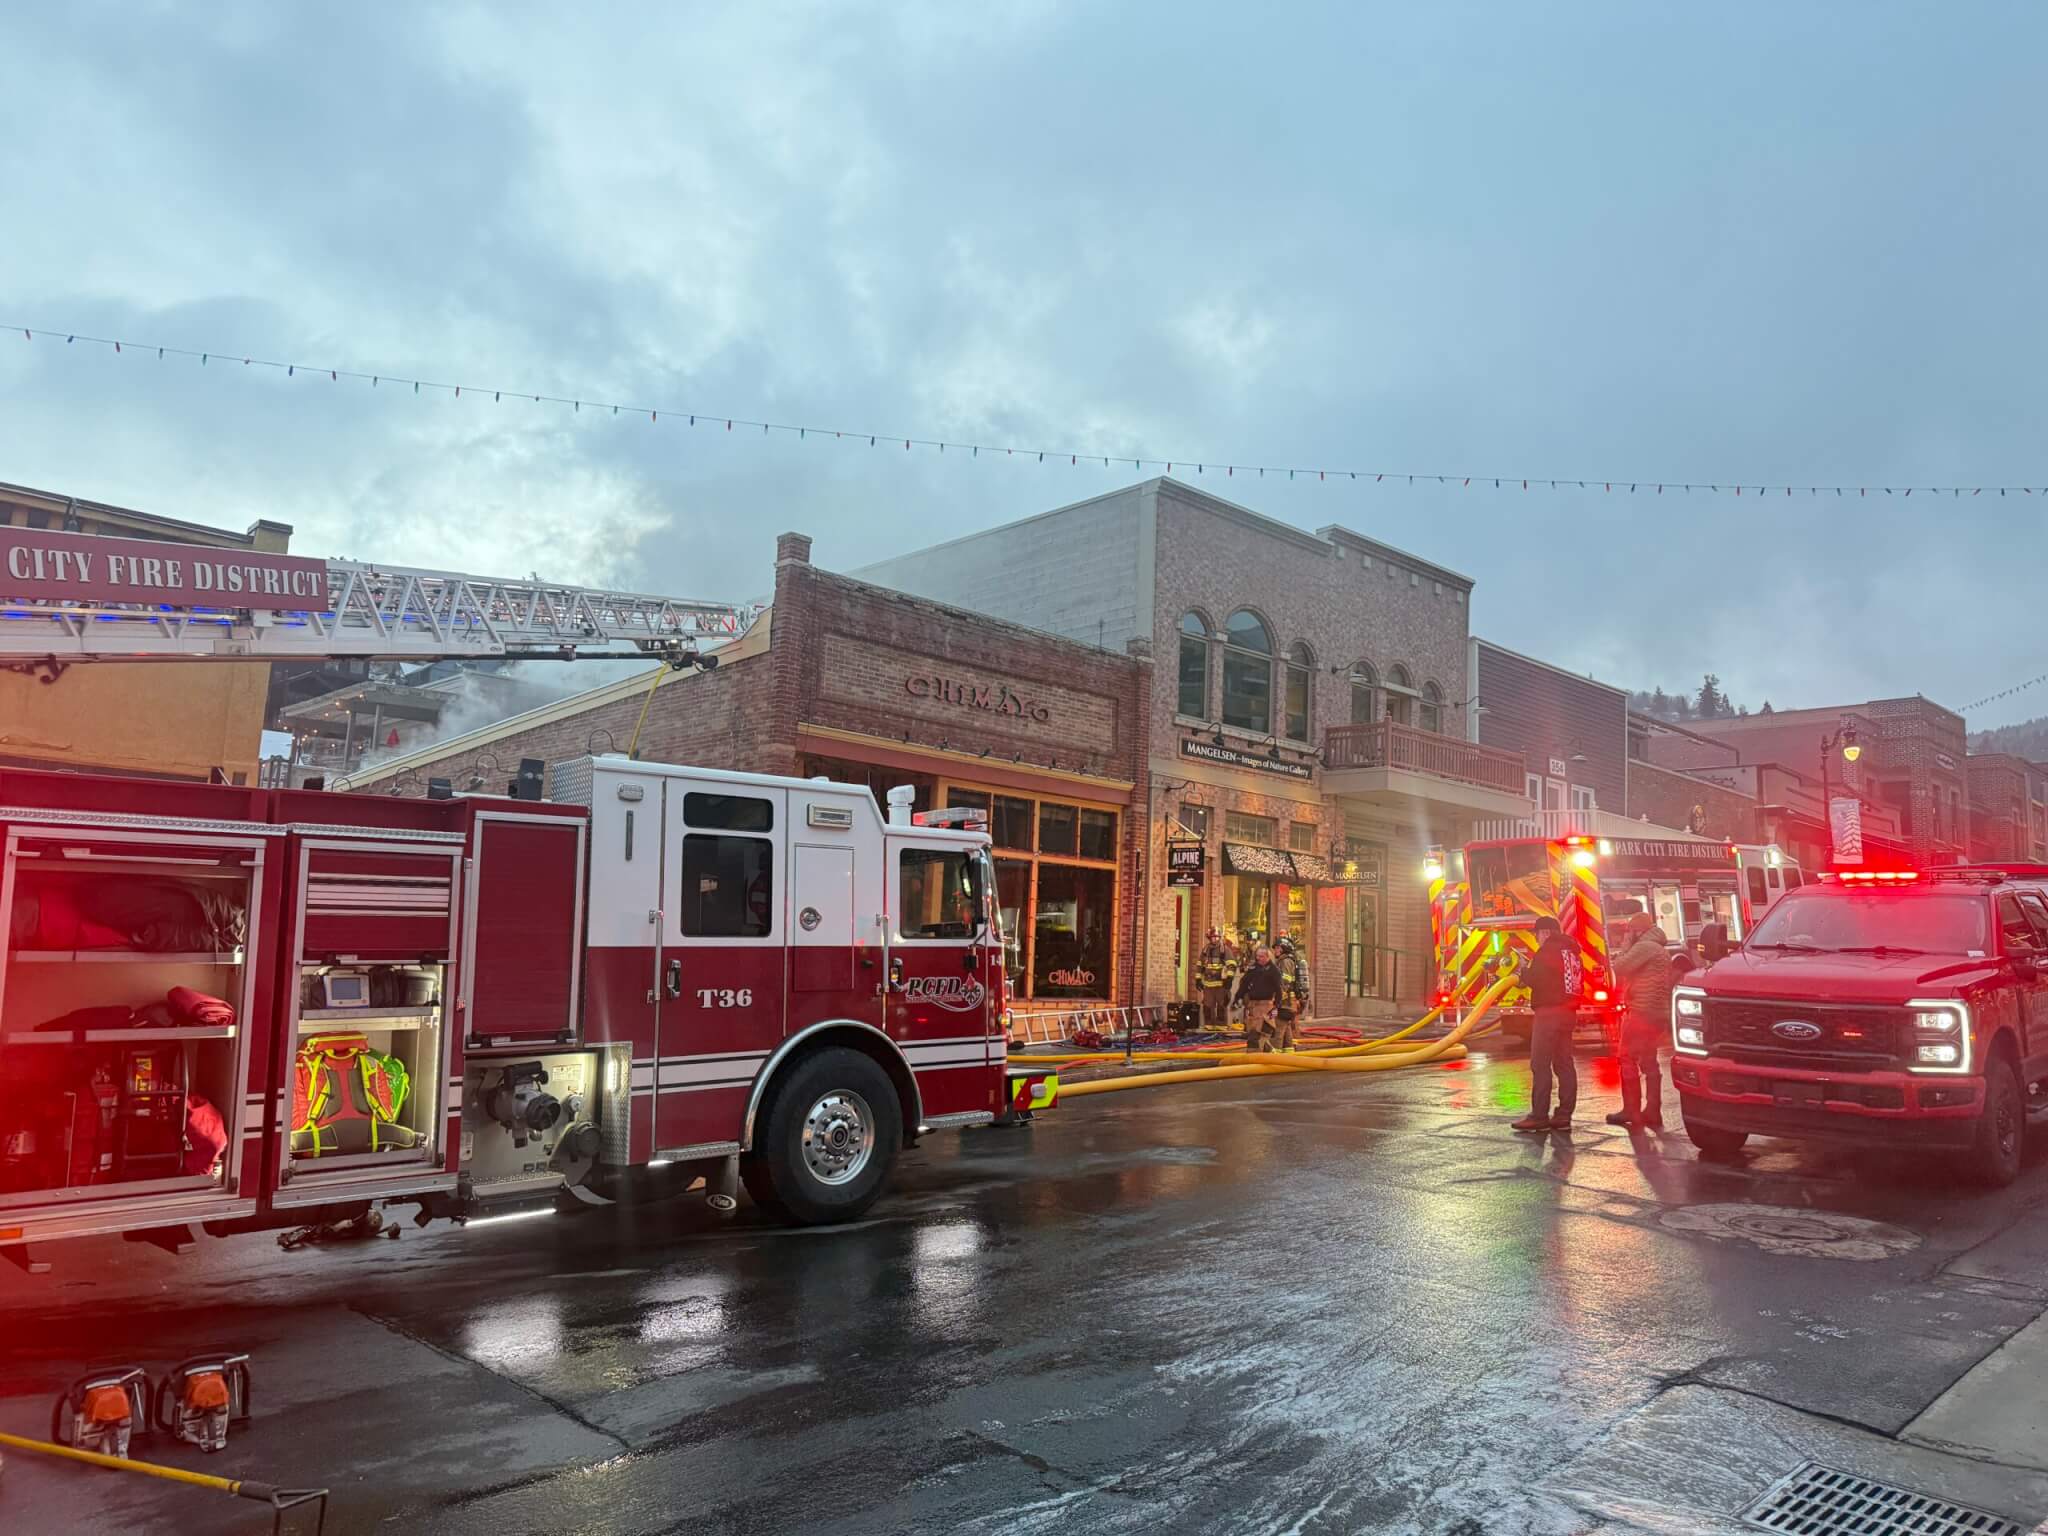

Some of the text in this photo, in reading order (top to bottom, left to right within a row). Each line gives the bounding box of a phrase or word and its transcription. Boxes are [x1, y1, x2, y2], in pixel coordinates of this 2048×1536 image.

[8, 546, 322, 598] CITY FIRE DISTRICT
[905, 676, 1049, 722] CHIMAYO
[1187, 741, 1237, 761] MANGELSEN
[1241, 755, 1262, 768] Images
[1270, 761, 1288, 772] Nature
[1289, 765, 1309, 777] Gallery
[1172, 851, 1200, 866] ALPINE
[1615, 841, 1729, 859] PARK CITY FIRE DISTRICT
[1048, 968, 1095, 985] CHIMAYO
[907, 977, 961, 996] PCFD
[696, 989, 753, 1008] T36
[1783, 1024, 1812, 1037] Ford
